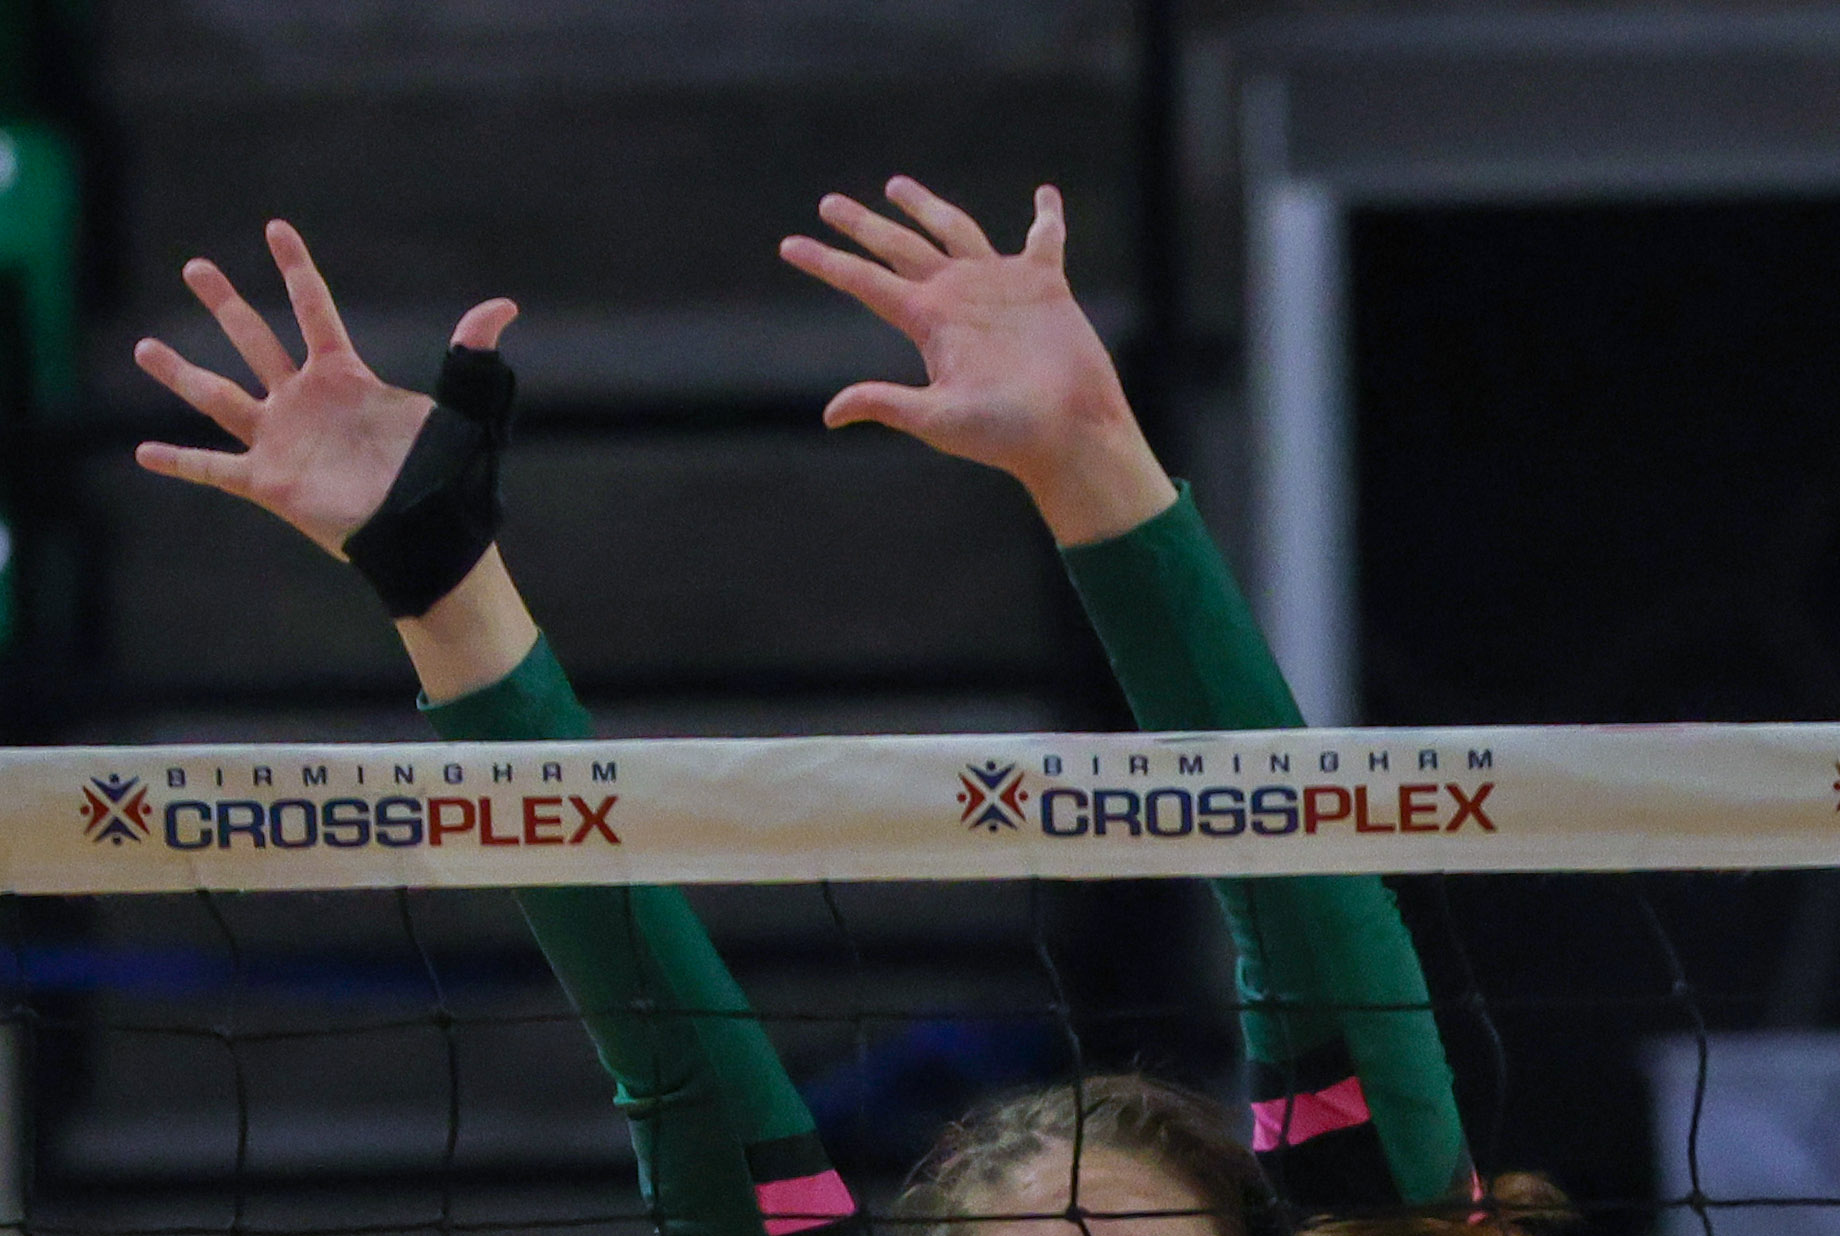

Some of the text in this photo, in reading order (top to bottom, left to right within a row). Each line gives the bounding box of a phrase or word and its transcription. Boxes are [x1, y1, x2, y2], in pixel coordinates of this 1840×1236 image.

[166, 763, 617, 787] BIRMINGHAM
[1042, 750, 1494, 775] BIRMINGHAM
[164, 796, 624, 850] CROSSPLEX
[1040, 782, 1499, 837] CROSSPLEX
